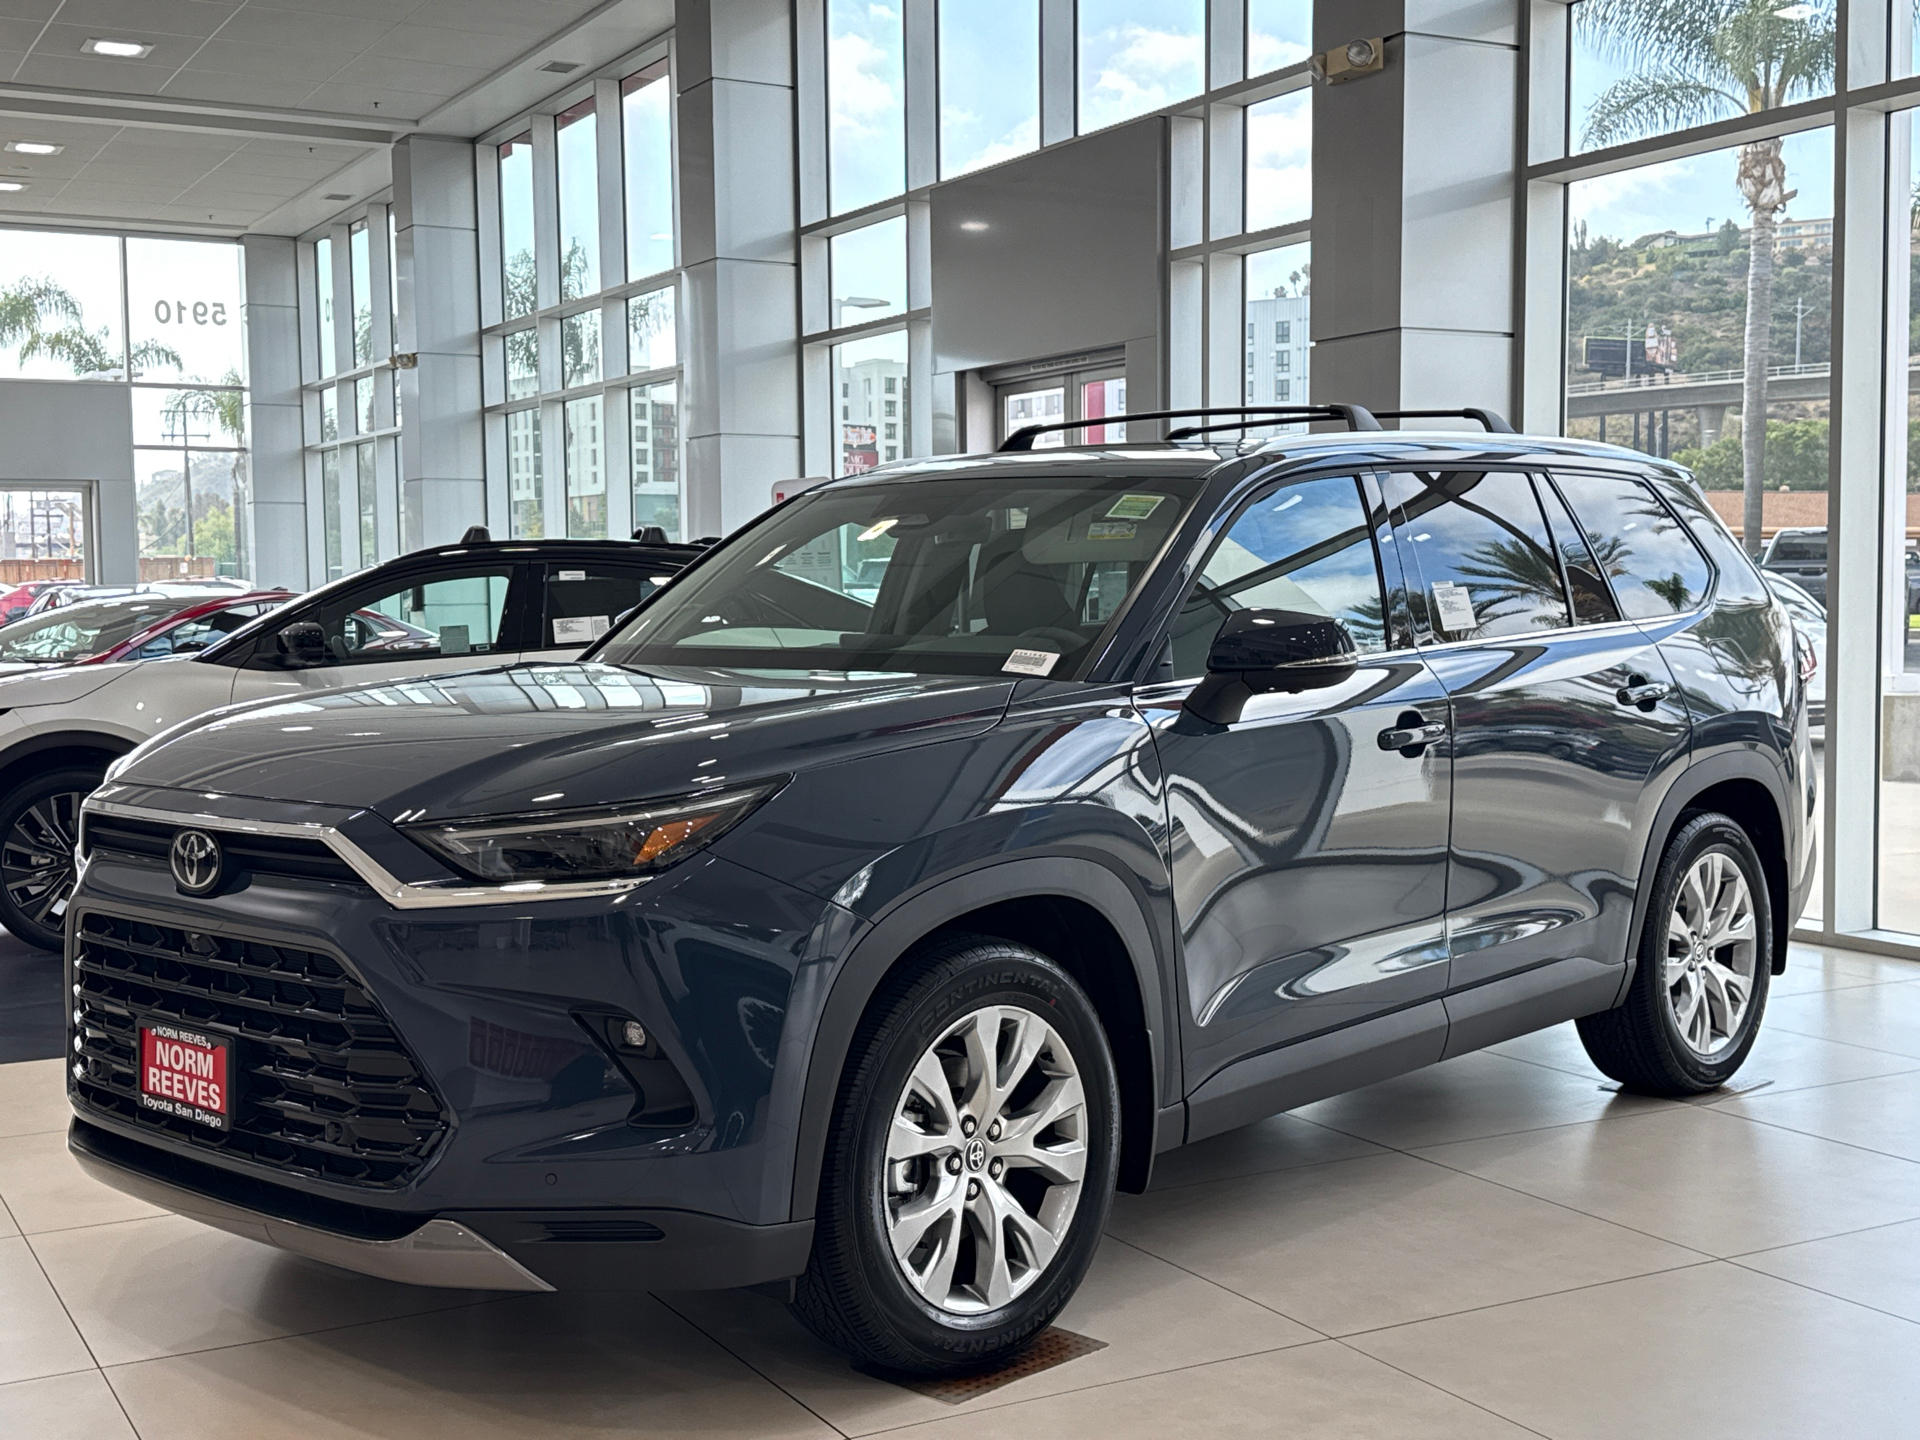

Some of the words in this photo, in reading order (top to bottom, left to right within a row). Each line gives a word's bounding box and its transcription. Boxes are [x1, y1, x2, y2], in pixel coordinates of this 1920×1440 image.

[920, 971, 1062, 1034] CONTINENTAL
[156, 1025, 178, 1040] NORM
[179, 1030, 207, 1047] REEVES
[156, 1040, 214, 1080] NORM
[148, 1066, 221, 1110] REEVES
[141, 1093, 173, 1112] Toyota
[175, 1102, 193, 1118] San
[195, 1108, 222, 1128] Diego
[931, 1277, 1073, 1354] CONTINENTAL
